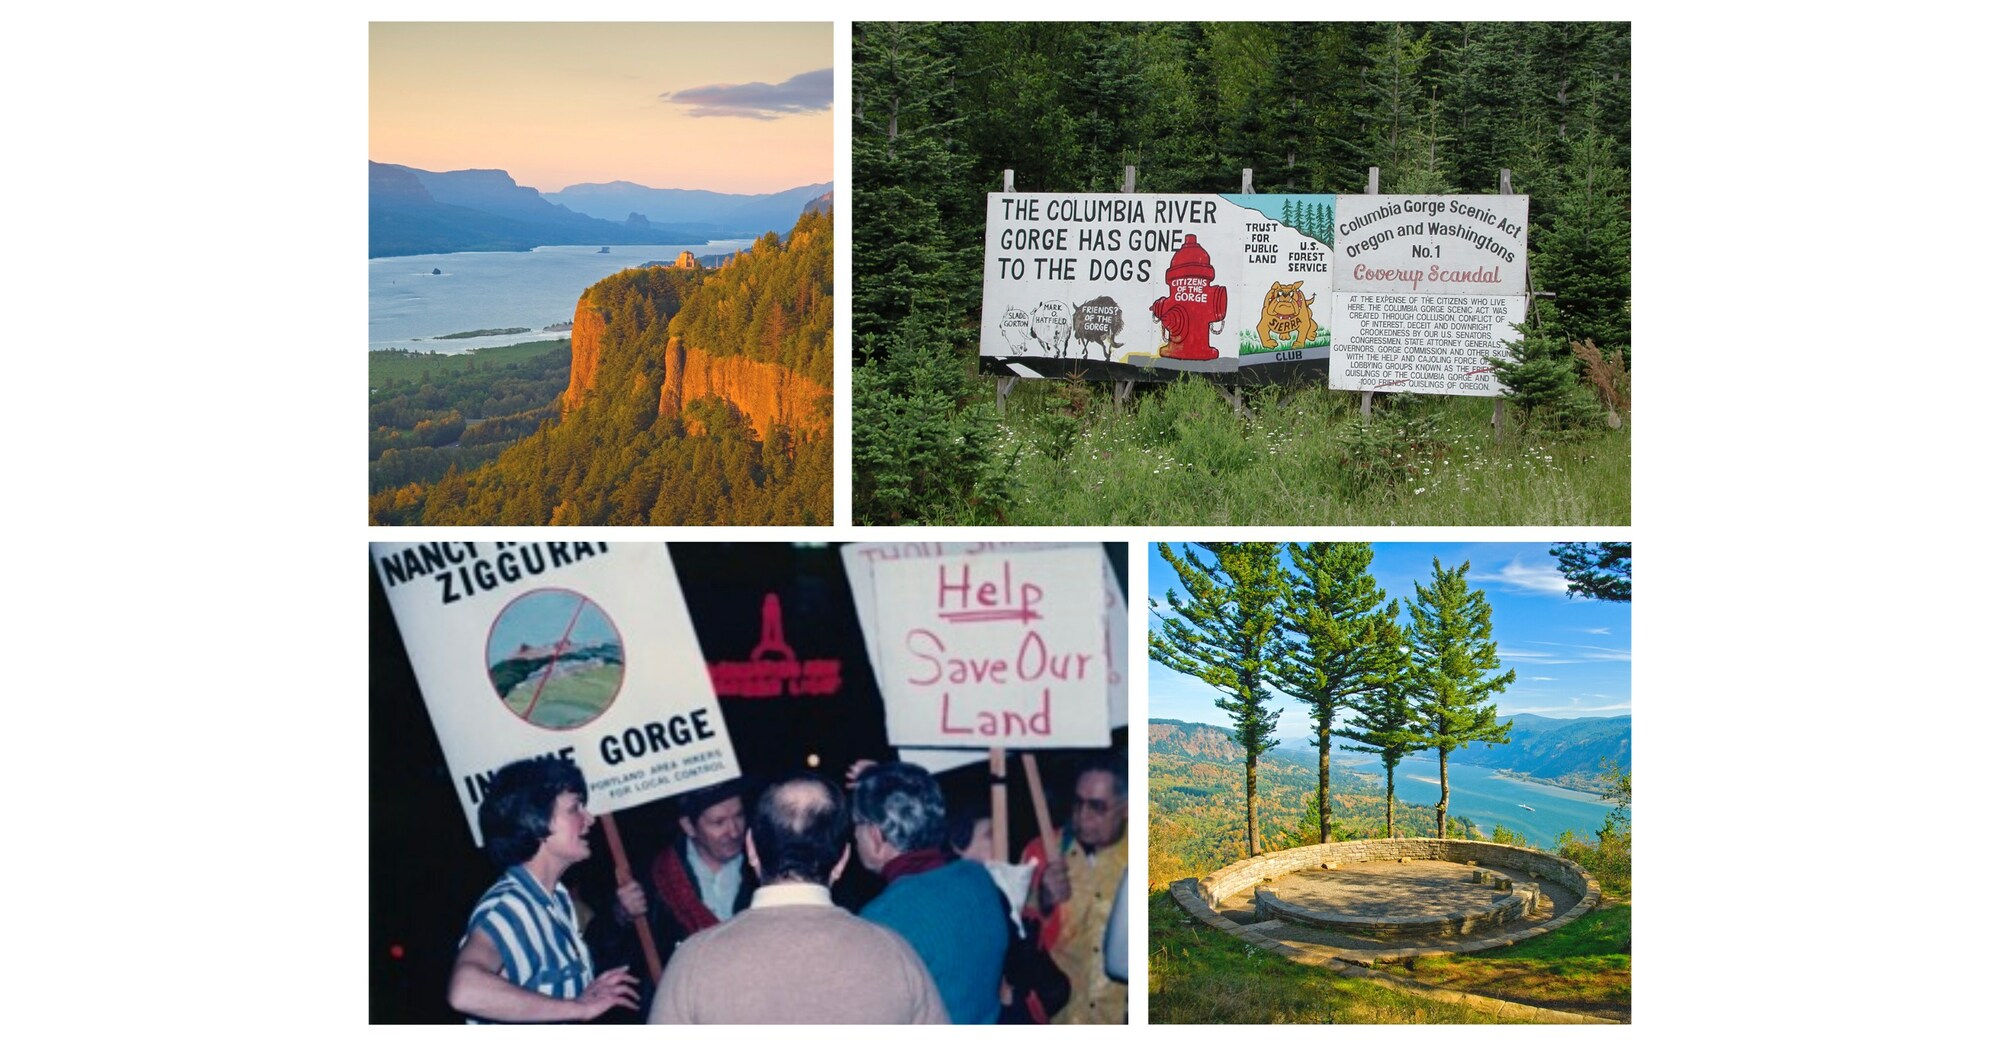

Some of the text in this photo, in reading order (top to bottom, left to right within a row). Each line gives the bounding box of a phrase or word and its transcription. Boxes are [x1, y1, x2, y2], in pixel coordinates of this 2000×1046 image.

[1002, 198, 1217, 224] THE COLUMBIA RIVER
[1339, 199, 1522, 239] Columbia Gorge Scenic Act
[1246, 223, 1278, 232] TRUST
[1001, 228, 1183, 252] GORGE HAS GONE
[1251, 234, 1270, 243] FOR
[1346, 222, 1515, 263] Oregon and Washingtons
[1244, 244, 1279, 253] PUBLIC
[1300, 242, 1319, 251] U.S.
[1248, 255, 1277, 264] LAND
[1288, 252, 1325, 261] FOREST
[998, 257, 1152, 282] TO THE DOGS
[1288, 263, 1327, 272] SERVICE
[1171, 278, 1208, 287] CITIZENS
[1353, 263, 1502, 291] Coverup Scandal
[1174, 293, 1208, 303] GORGE
[1375, 296, 1406, 304] EXPENSE
[1408, 296, 1418, 304] OF
[1436, 297, 1468, 305] CITIZENS
[1471, 298, 1488, 306] WHO
[1043, 303, 1062, 311] MARK
[1082, 306, 1119, 316] FRIENDS?
[1384, 304, 1418, 312] COLUMBIA
[1420, 305, 1444, 313] GORGE
[1447, 306, 1473, 314] SCENIC
[1493, 307, 1508, 315] WAS
[1035, 316, 1067, 325] HATFIELD
[1097, 315, 1113, 323] THE
[1382, 312, 1414, 320] THROUGH
[1458, 314, 1492, 323] CONFLICT
[1495, 315, 1505, 323] OF
[1084, 323, 1109, 331] GORGE
[1268, 316, 1303, 332] SIERRA
[1407, 321, 1431, 329] DECEIT
[1434, 322, 1448, 330] AND
[1450, 323, 1493, 331] DOWNRIGHT
[1360, 328, 1410, 336] CROOKEDNESS
[1424, 330, 1438, 338] OUR
[1404, 338, 1424, 346] STATE
[1426, 339, 1462, 347] ATTORNEY
[1275, 350, 1303, 361] CLUB
[1377, 345, 1401, 353] GORGE
[1404, 346, 1447, 355] COMMISSION
[1450, 348, 1464, 356] AND
[1381, 354, 1398, 362] HELP
[1454, 357, 1477, 365] FORCE
[1350, 361, 1382, 369] LOBBYING
[1415, 364, 1442, 372] KNOWN
[1345, 369, 1380, 377] QUISLINGS
[1410, 372, 1444, 380] COLUMBIA
[1448, 373, 1472, 381] GORGE
[1475, 374, 1489, 382] AND
[1379, 379, 1406, 387] FRIENDS
[1408, 380, 1444, 388] QUISLINGS
[380, 542, 479, 587] NANCY
[939, 560, 1044, 625] Help
[906, 629, 1009, 687] Save
[1016, 630, 1093, 682] Our
[941, 688, 1051, 737] Land
[600, 708, 715, 766] GORGE
[590, 749, 723, 791] PORTLAND AREA HIKERS
[609, 760, 725, 798] FOR LOCAL CONTROL
